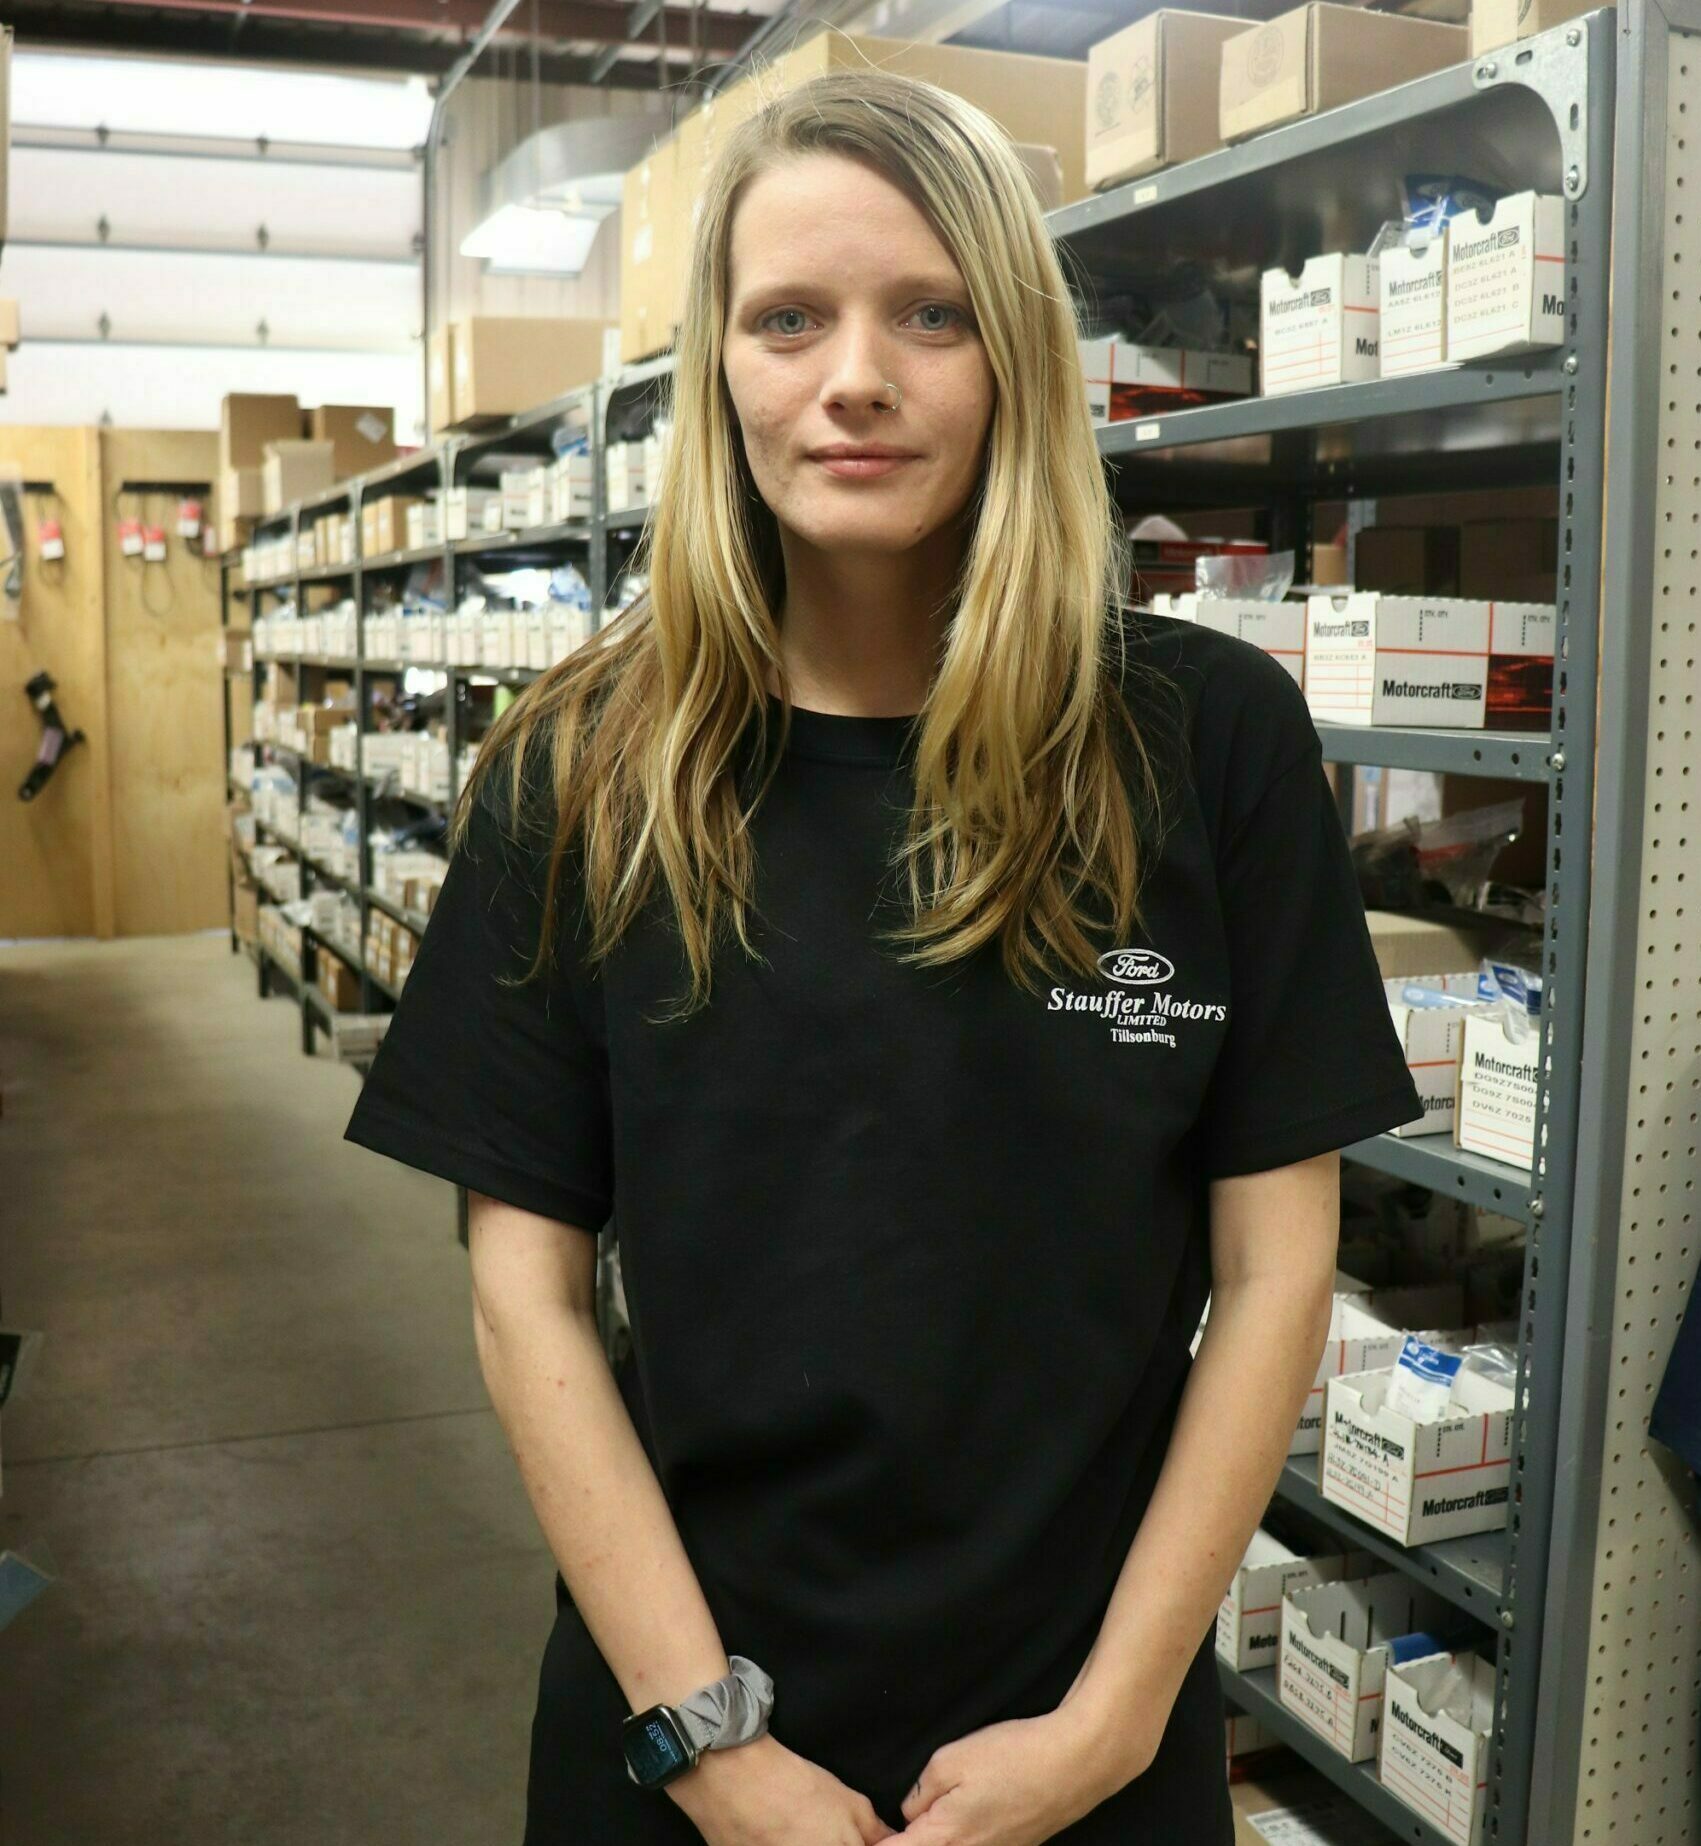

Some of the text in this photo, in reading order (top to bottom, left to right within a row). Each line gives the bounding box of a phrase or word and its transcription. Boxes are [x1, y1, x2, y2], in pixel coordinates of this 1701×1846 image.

[1453, 231, 1497, 263] Motorcraft
[1388, 271, 1435, 297] Motorcraft
[1269, 292, 1310, 316] Motorcraft
[1542, 293, 1564, 316] Mo
[1313, 620, 1350, 638] Motorcraft
[1382, 679, 1451, 699] Motorcraft
[1113, 953, 1160, 979] Ford
[1047, 987, 1227, 1021] Stauffer Motors
[1117, 1015, 1167, 1026] LIMITED
[1110, 1028, 1176, 1048] Tillsonburg
[1474, 1051, 1533, 1081] Motorcraft
[1422, 1490, 1485, 1517] Motorcraft
[1289, 1630, 1330, 1674] Motorcraft
[1391, 1700, 1440, 1751] Motorcraft
